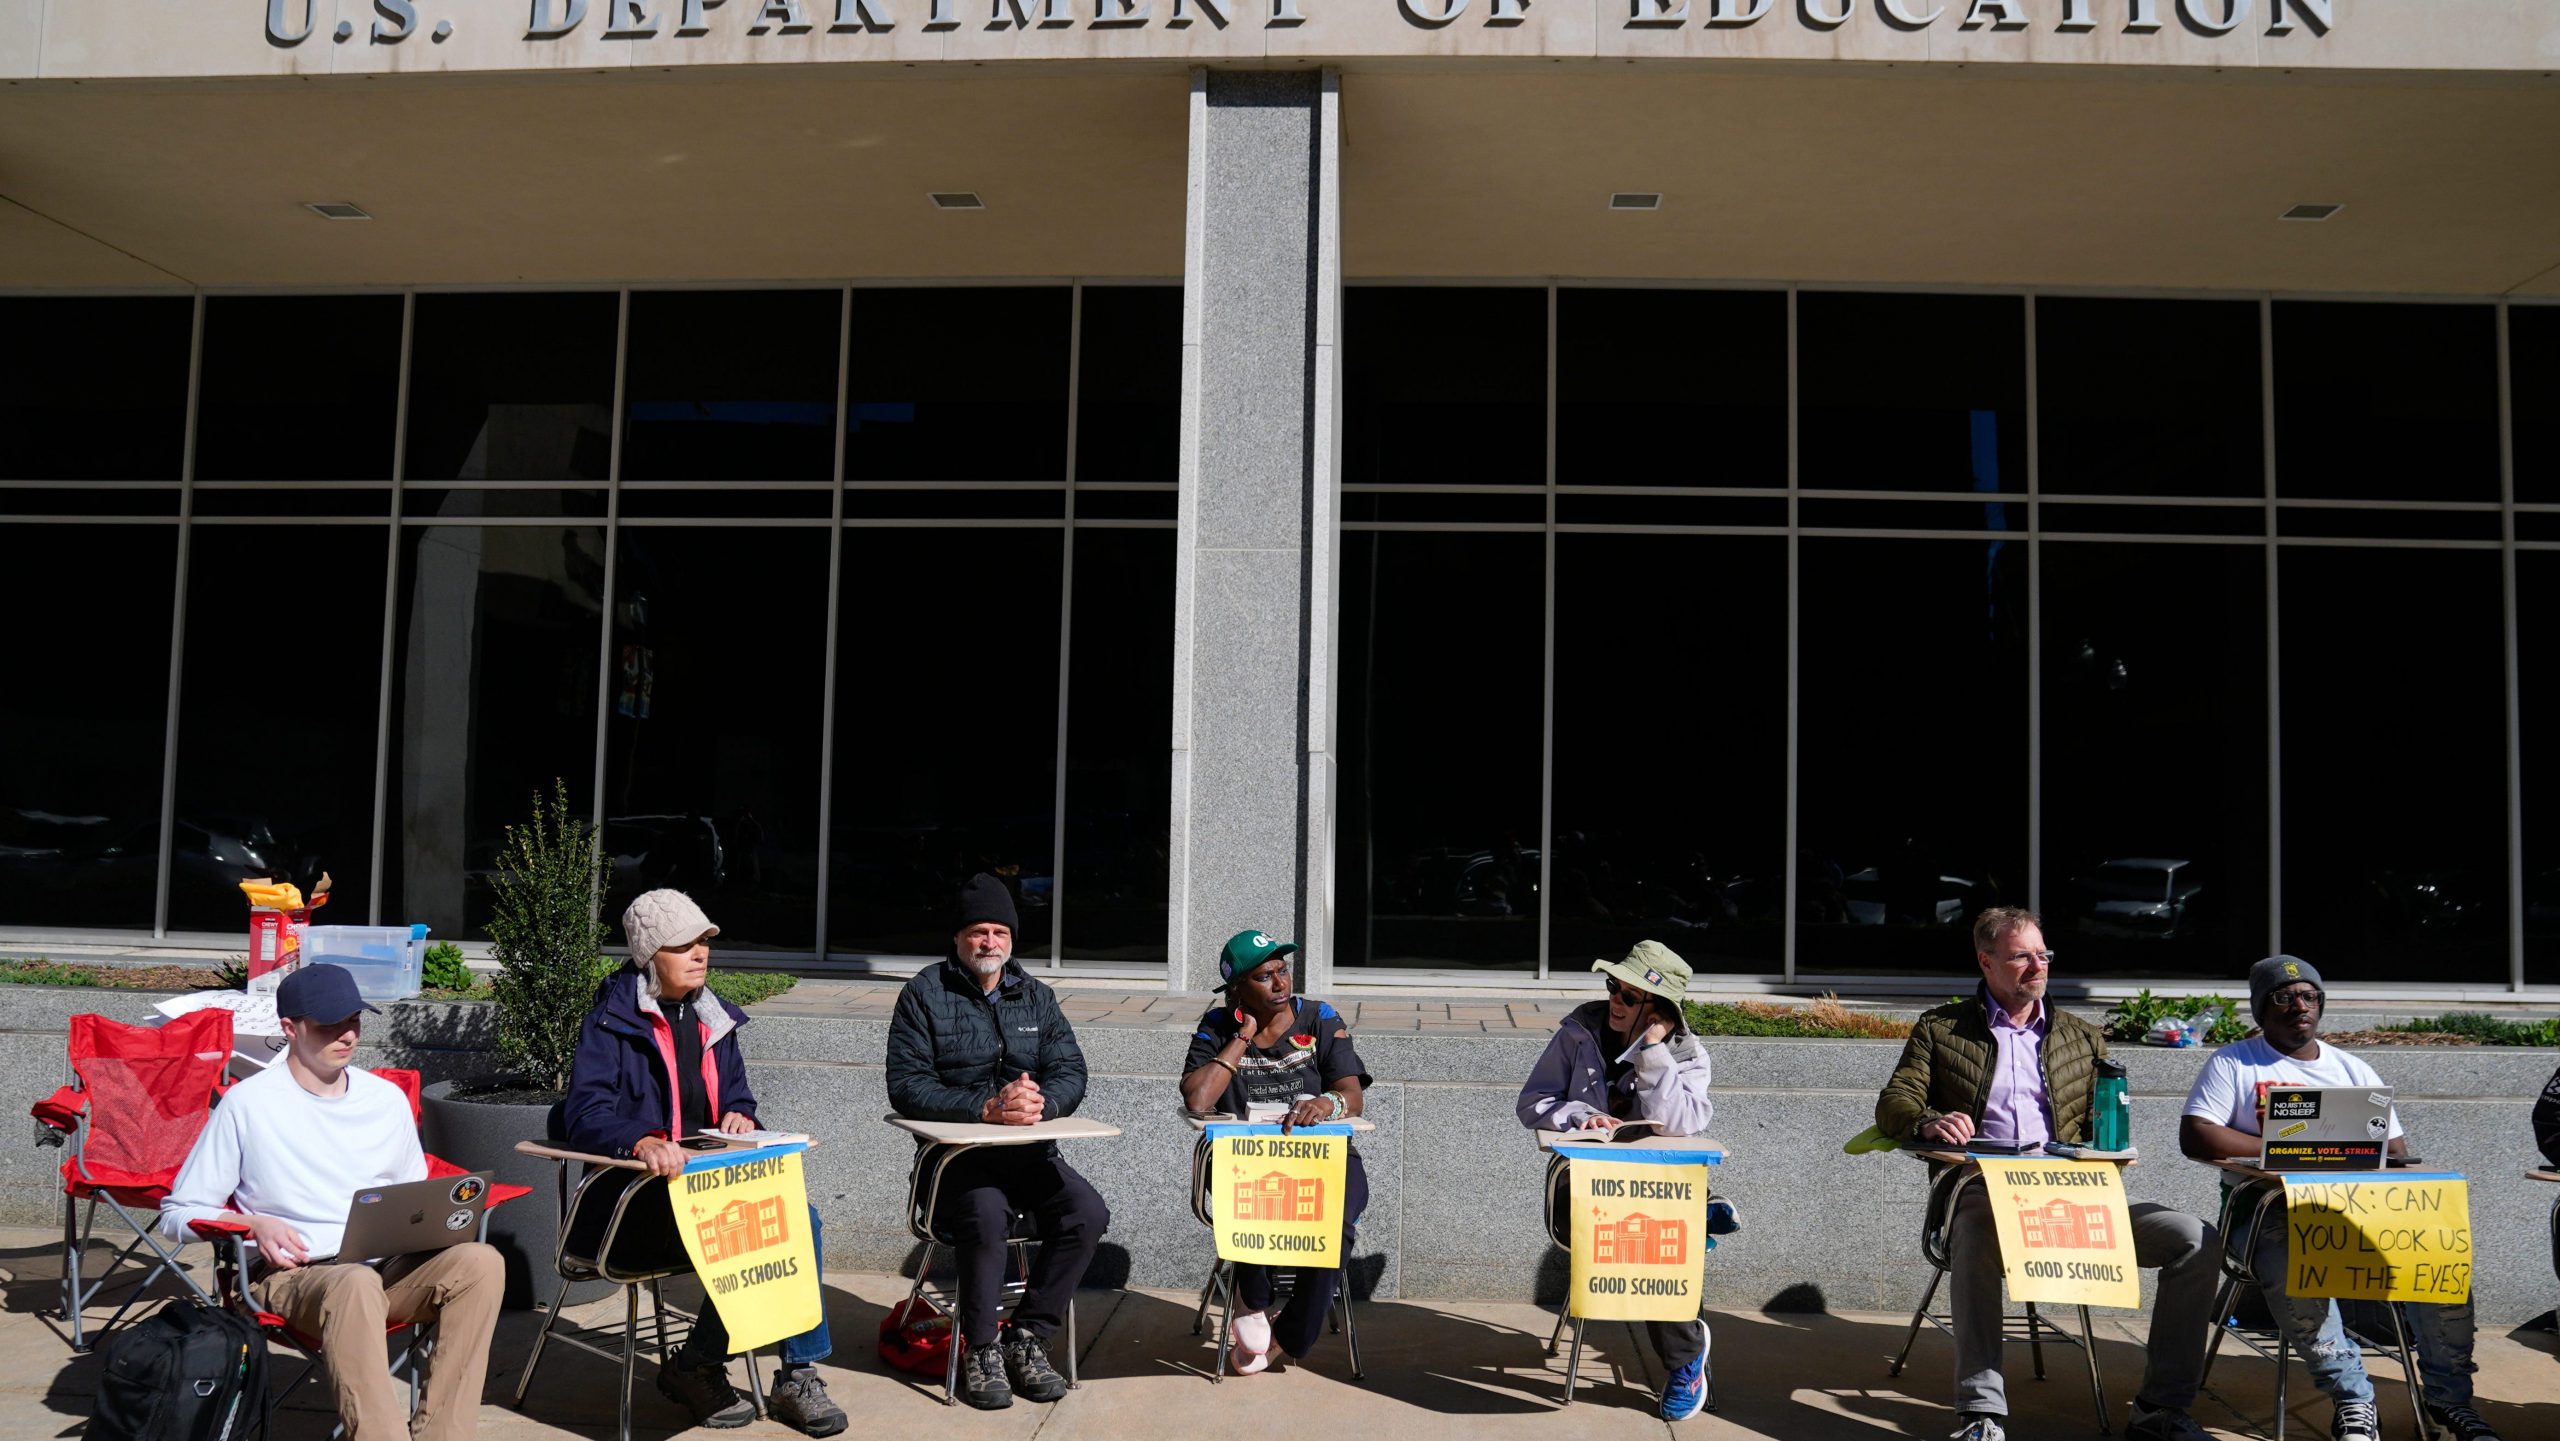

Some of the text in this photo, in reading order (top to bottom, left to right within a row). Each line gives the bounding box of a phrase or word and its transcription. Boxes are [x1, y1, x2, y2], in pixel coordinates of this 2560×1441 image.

[2289, 1108, 2316, 1116] SLEEP
[1232, 1138, 1329, 1159] KIDS DESERVE
[2269, 1147, 2378, 1155] ORGANIZE. VOTE. STRIKE.
[686, 1155, 785, 1195] KIDS DESERVE
[2004, 1170, 2109, 1187] KIDS DESERVE
[1591, 1178, 1692, 1200] KIDS DESERVE
[2292, 1183, 2442, 1214] MUSK: CAN
[1232, 1232, 1326, 1252] GOOD SCHOOLS
[2294, 1223, 2469, 1255] YOU LOOK US
[712, 1256, 798, 1295] GOOD SCHOOLS
[2024, 1260, 2123, 1282] GOOD SCHOOLS
[2298, 1262, 2470, 1295] IN THE EYES?
[1589, 1276, 1688, 1296] GOOD SCHOOLS
